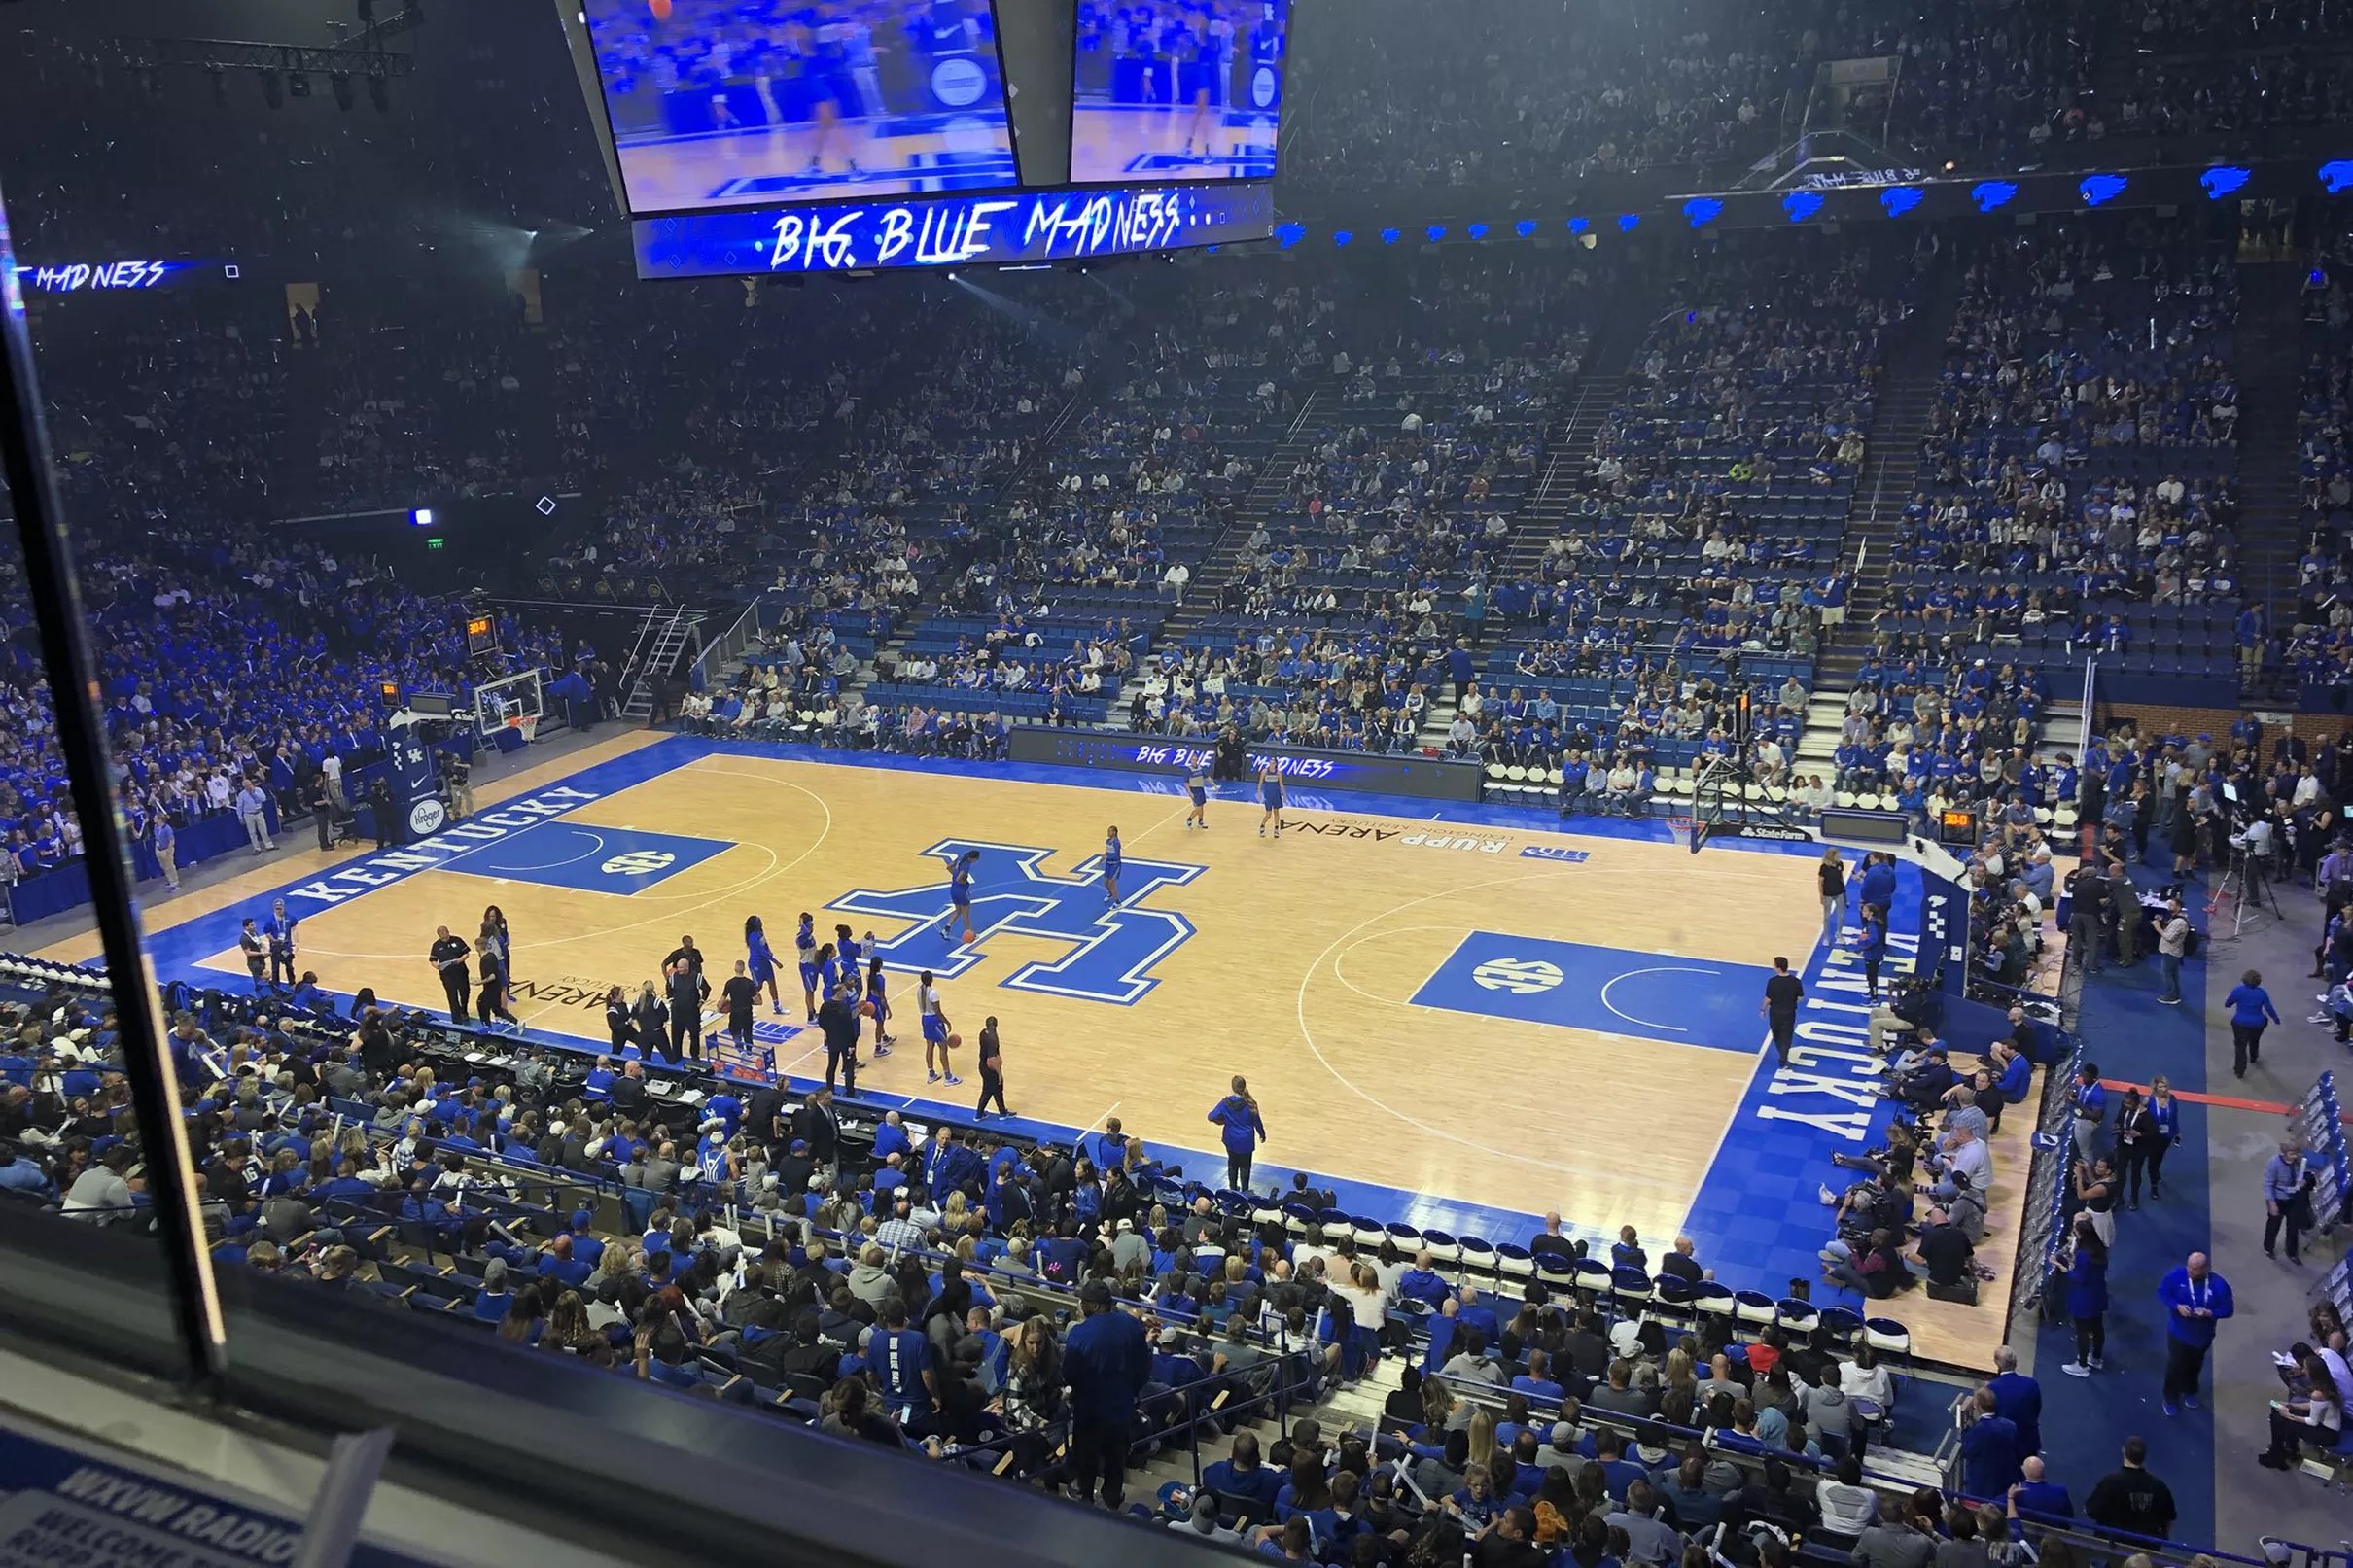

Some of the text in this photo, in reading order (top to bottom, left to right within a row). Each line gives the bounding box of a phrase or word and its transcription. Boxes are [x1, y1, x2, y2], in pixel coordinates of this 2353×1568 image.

[877, 201, 1018, 264] BLUE
[1024, 193, 1180, 258] MADNESS
[36, 260, 165, 292] MADNESS
[1136, 746, 1172, 764] BIG
[1252, 754, 1334, 778] MDNESS
[415, 808, 440, 827] Kroger
[288, 785, 600, 902] KENTUCKY
[1280, 819, 1509, 854] RUPP ARENA
[601, 851, 675, 875] SEC
[1472, 958, 1563, 993] SEC
[241, 1167, 259, 1184] 16
[170, 1504, 302, 1563] RADIO
